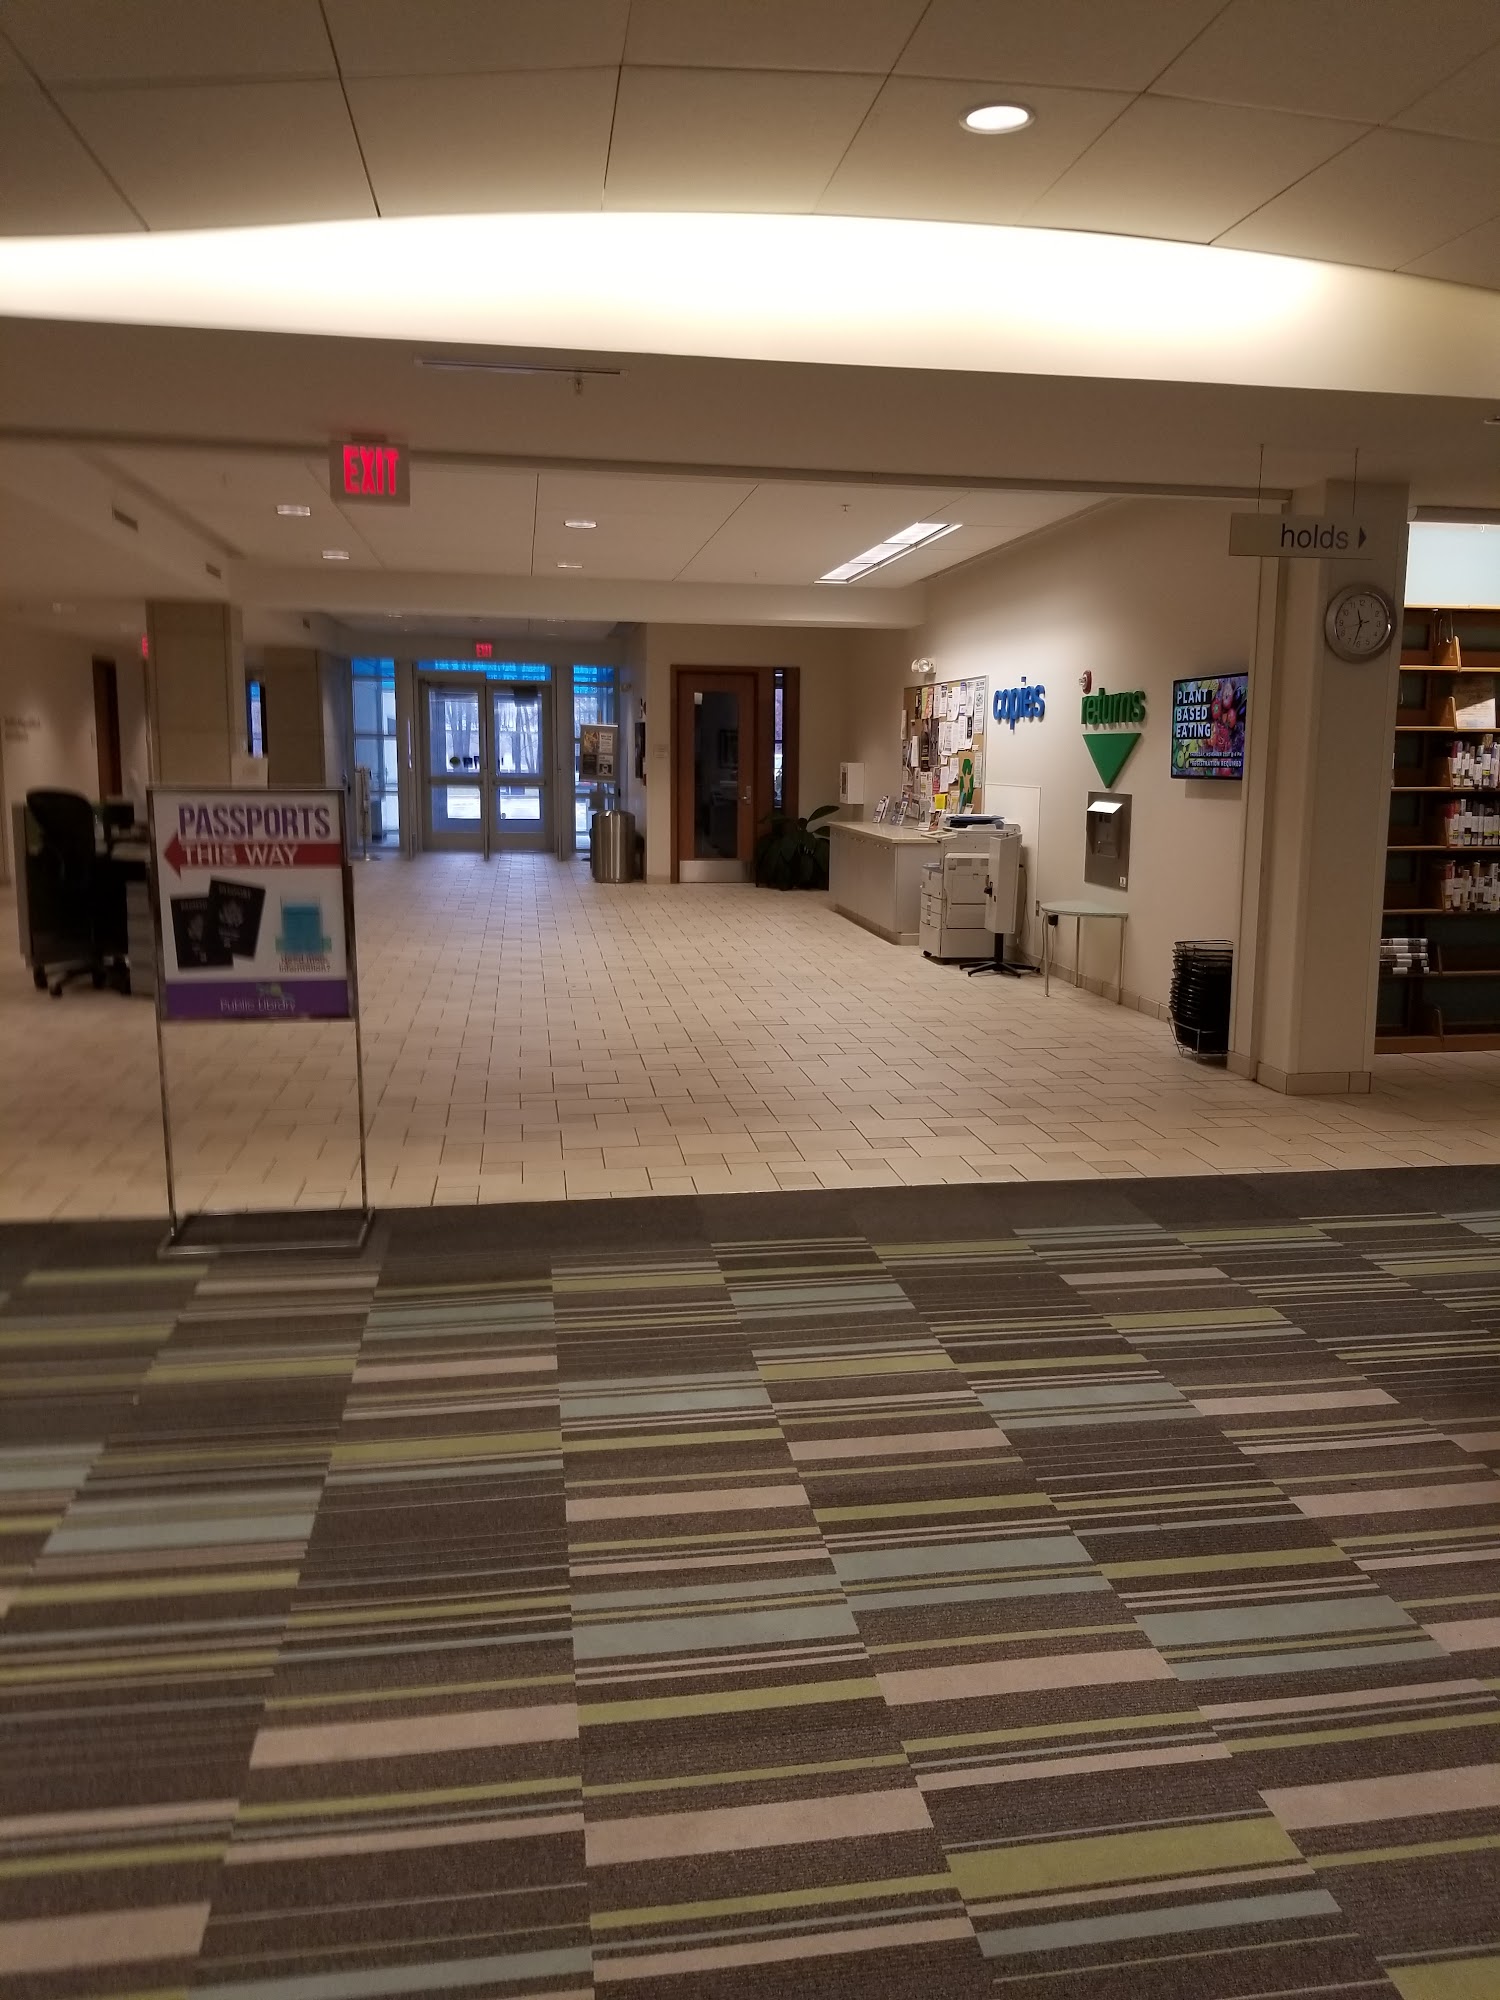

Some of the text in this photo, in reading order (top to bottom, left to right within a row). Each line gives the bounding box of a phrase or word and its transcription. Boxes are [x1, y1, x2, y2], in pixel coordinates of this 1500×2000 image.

[343, 445, 399, 495] EXIT
[1280, 523, 1349, 550] holds
[476, 643, 492, 658] EXIT
[993, 676, 1046, 731] copies
[1081, 688, 1146, 725] returns
[1177, 689, 1207, 704] PLANT
[1176, 706, 1208, 721] BASED
[1176, 722, 1211, 738] EATING
[178, 803, 331, 840] PASSPORTS
[182, 843, 299, 866] THIS WAY
[258, 997, 296, 1014] Library
